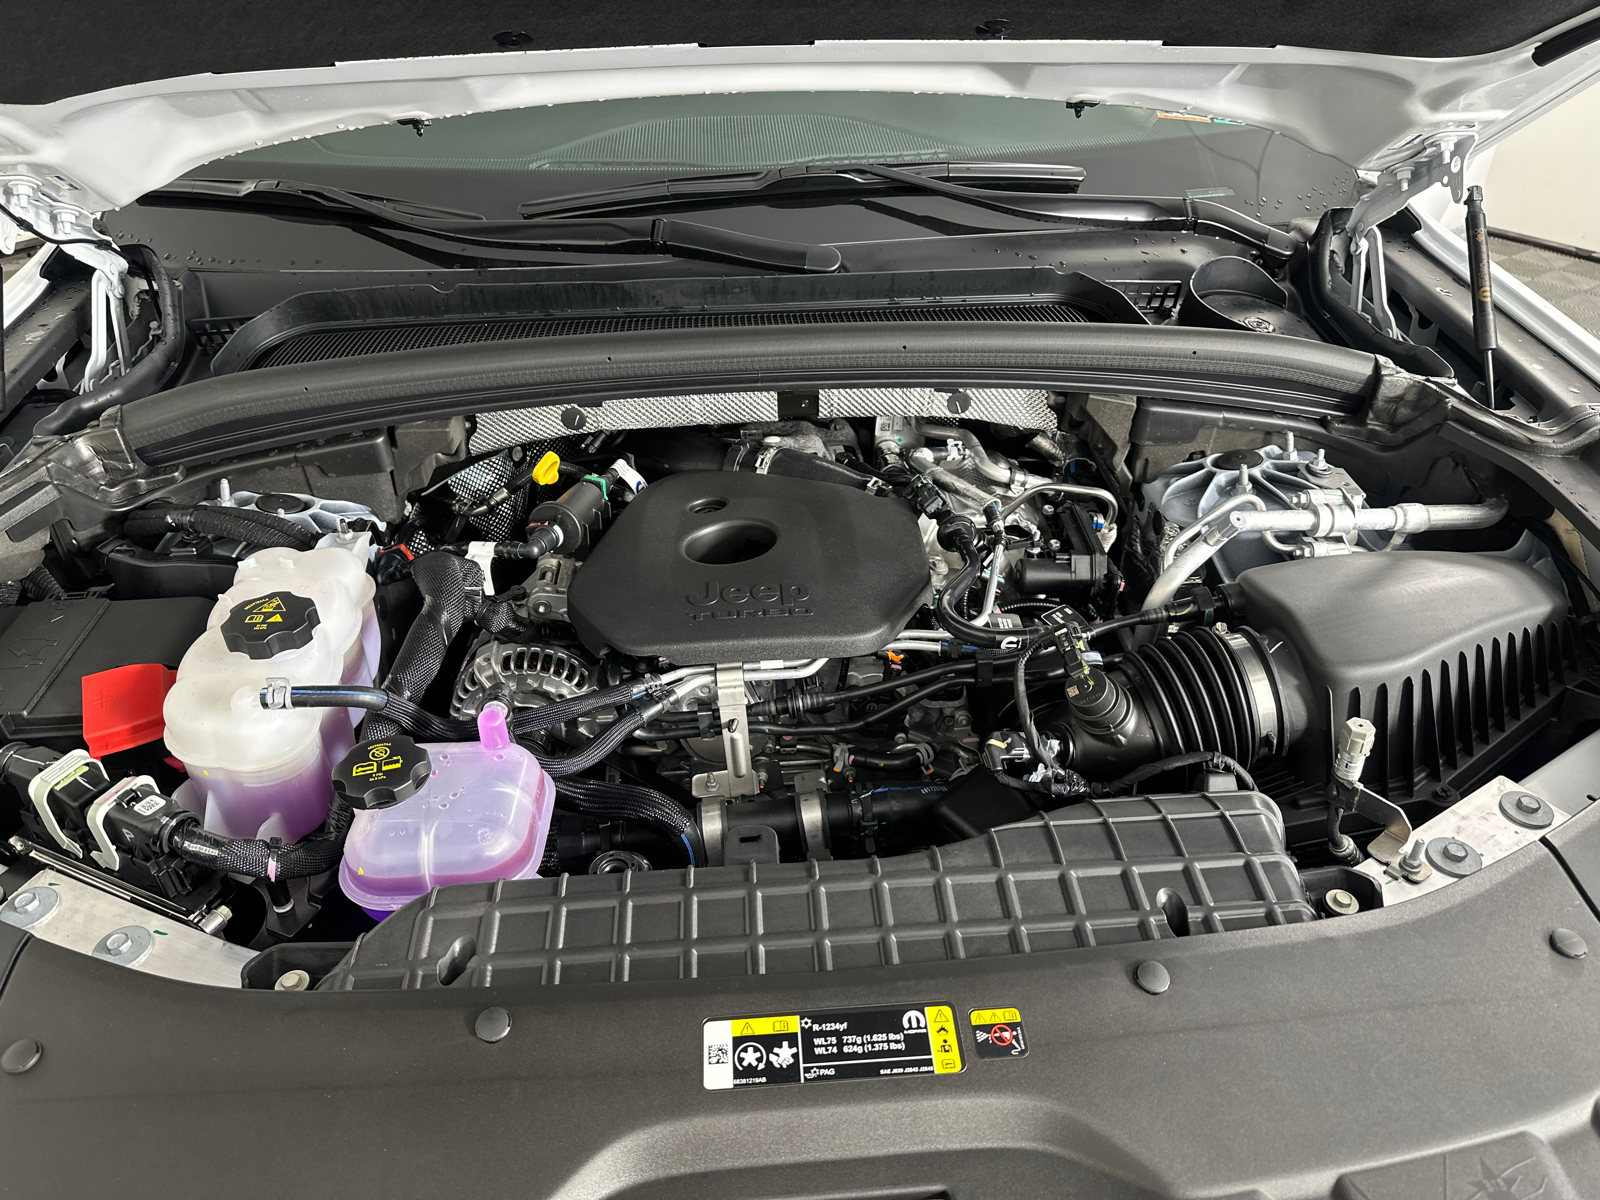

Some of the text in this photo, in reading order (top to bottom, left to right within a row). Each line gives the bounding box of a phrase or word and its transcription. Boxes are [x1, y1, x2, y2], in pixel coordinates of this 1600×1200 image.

[685, 581, 811, 606] Jeep
[686, 608, 814, 621] TURBO
[812, 1022, 848, 1031] R-1234yf
[813, 1032, 905, 1046] WL75 737g (1.625 lbs)
[814, 1041, 906, 1055] WL74 624g (1.375 lbs)
[820, 1067, 836, 1076] PAG
